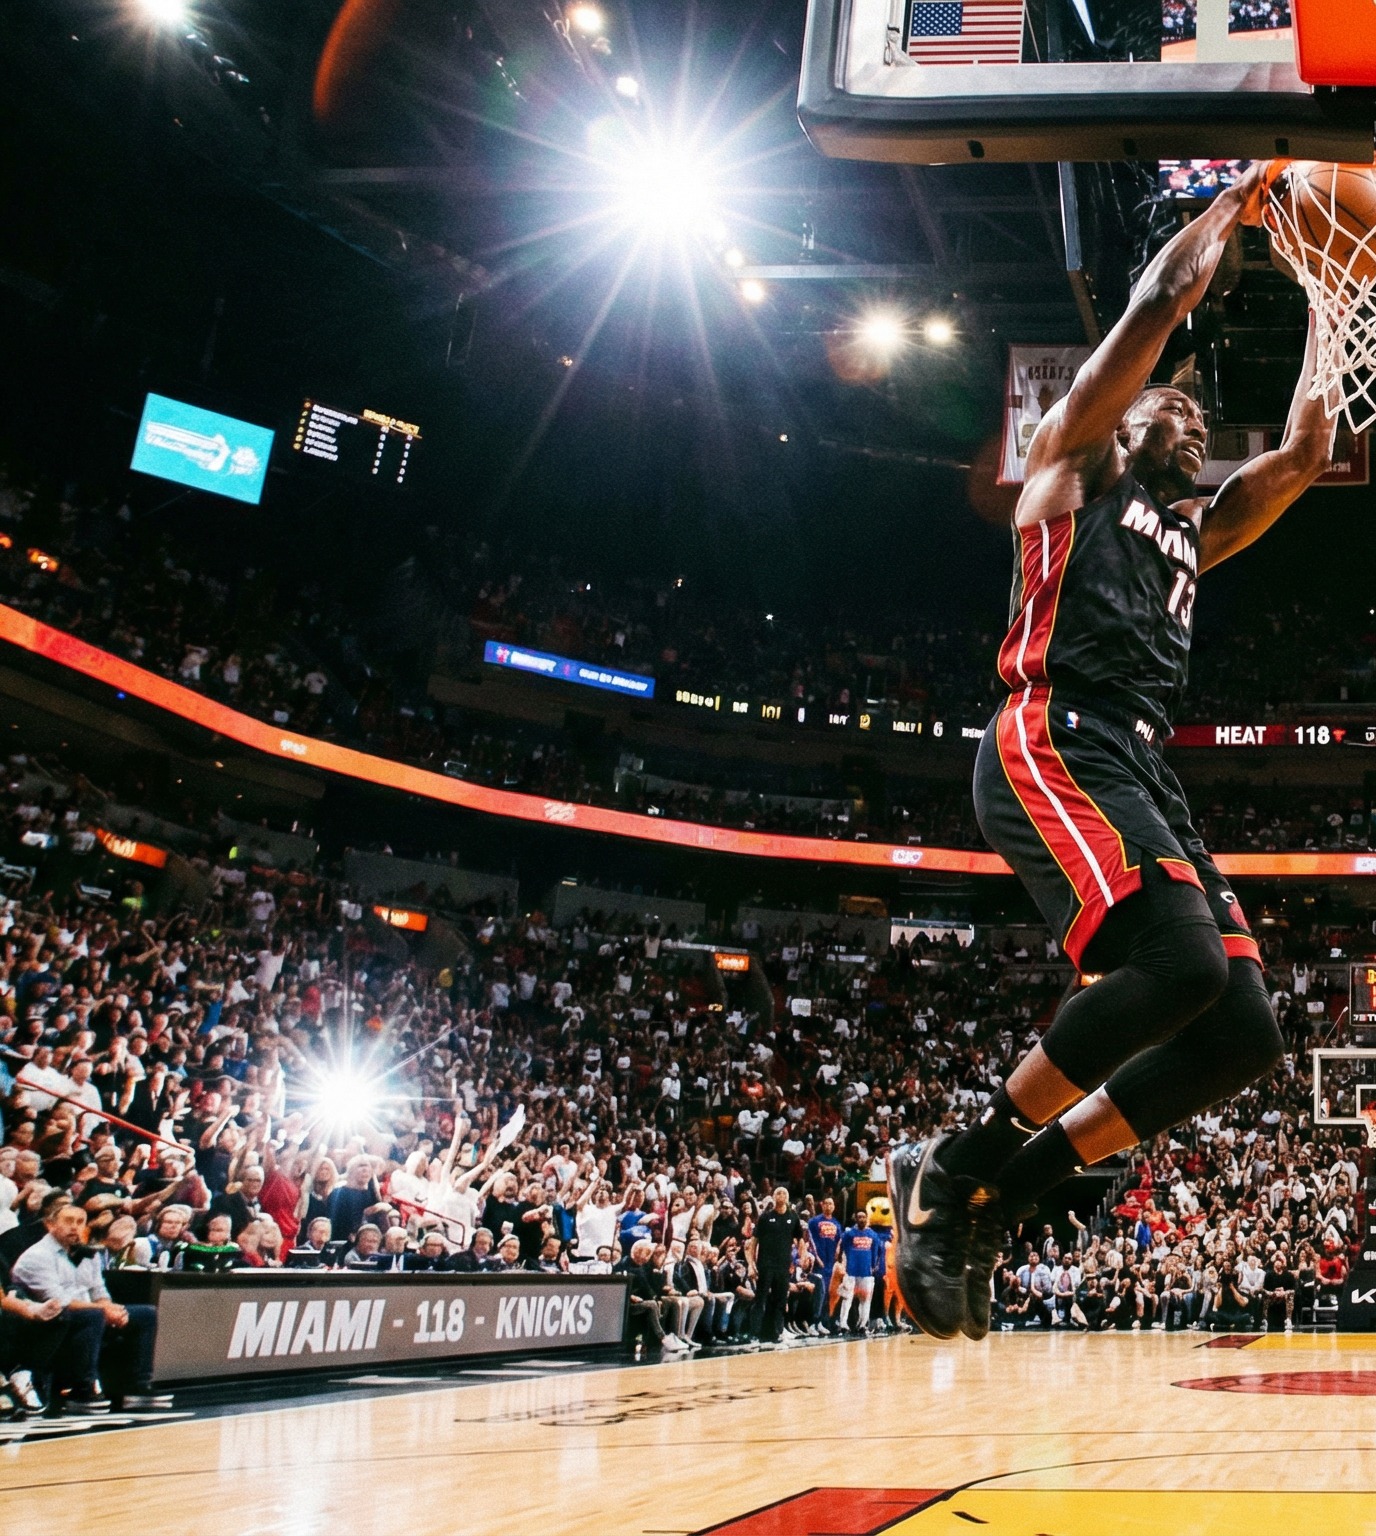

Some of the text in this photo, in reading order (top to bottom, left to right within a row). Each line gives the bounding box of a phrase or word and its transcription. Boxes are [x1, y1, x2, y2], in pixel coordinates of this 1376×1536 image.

[1167, 570, 1196, 630] 13
[1215, 725, 1331, 744] HEAT 118
[226, 1299, 387, 1359] MIAMI
[413, 1298, 466, 1343] 118
[495, 1294, 595, 1339] KNICKS
